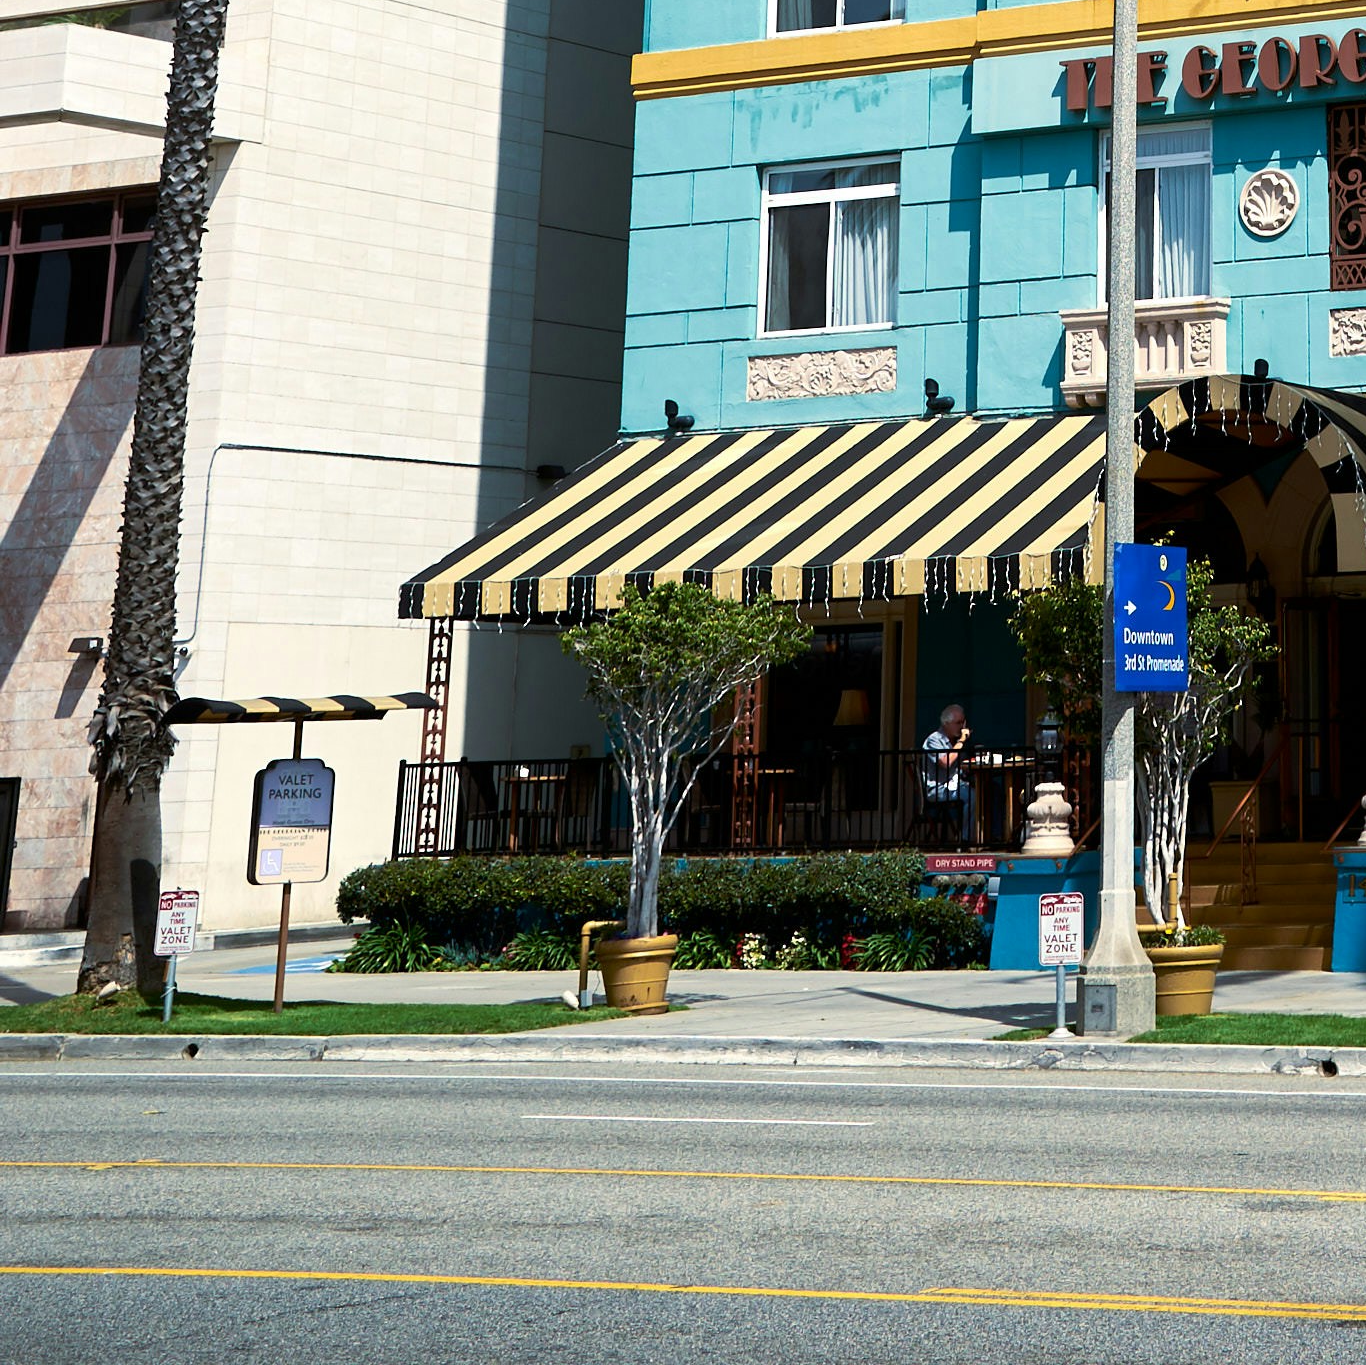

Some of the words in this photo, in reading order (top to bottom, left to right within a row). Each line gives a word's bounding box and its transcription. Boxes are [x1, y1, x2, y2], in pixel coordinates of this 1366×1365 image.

[1123, 627, 1174, 646] Downtown
[1124, 653, 1137, 671] 3rd
[1138, 654, 1145, 671] St
[1146, 655, 1184, 672] Promenade
[278, 773, 315, 786] VALET
[268, 788, 322, 800] PARKING
[935, 859, 951, 868] DRY
[951, 859, 975, 868] STAND
[976, 858, 994, 867] PIPE
[161, 900, 173, 909] NO
[1041, 905, 1054, 915] NO
[1056, 906, 1080, 914] PARKING
[161, 926, 192, 936] VALET
[1053, 924, 1070, 932] TIME
[161, 935, 189, 944] ZONE
[1044, 933, 1078, 943] VALET
[1046, 944, 1077, 953] ZONE
